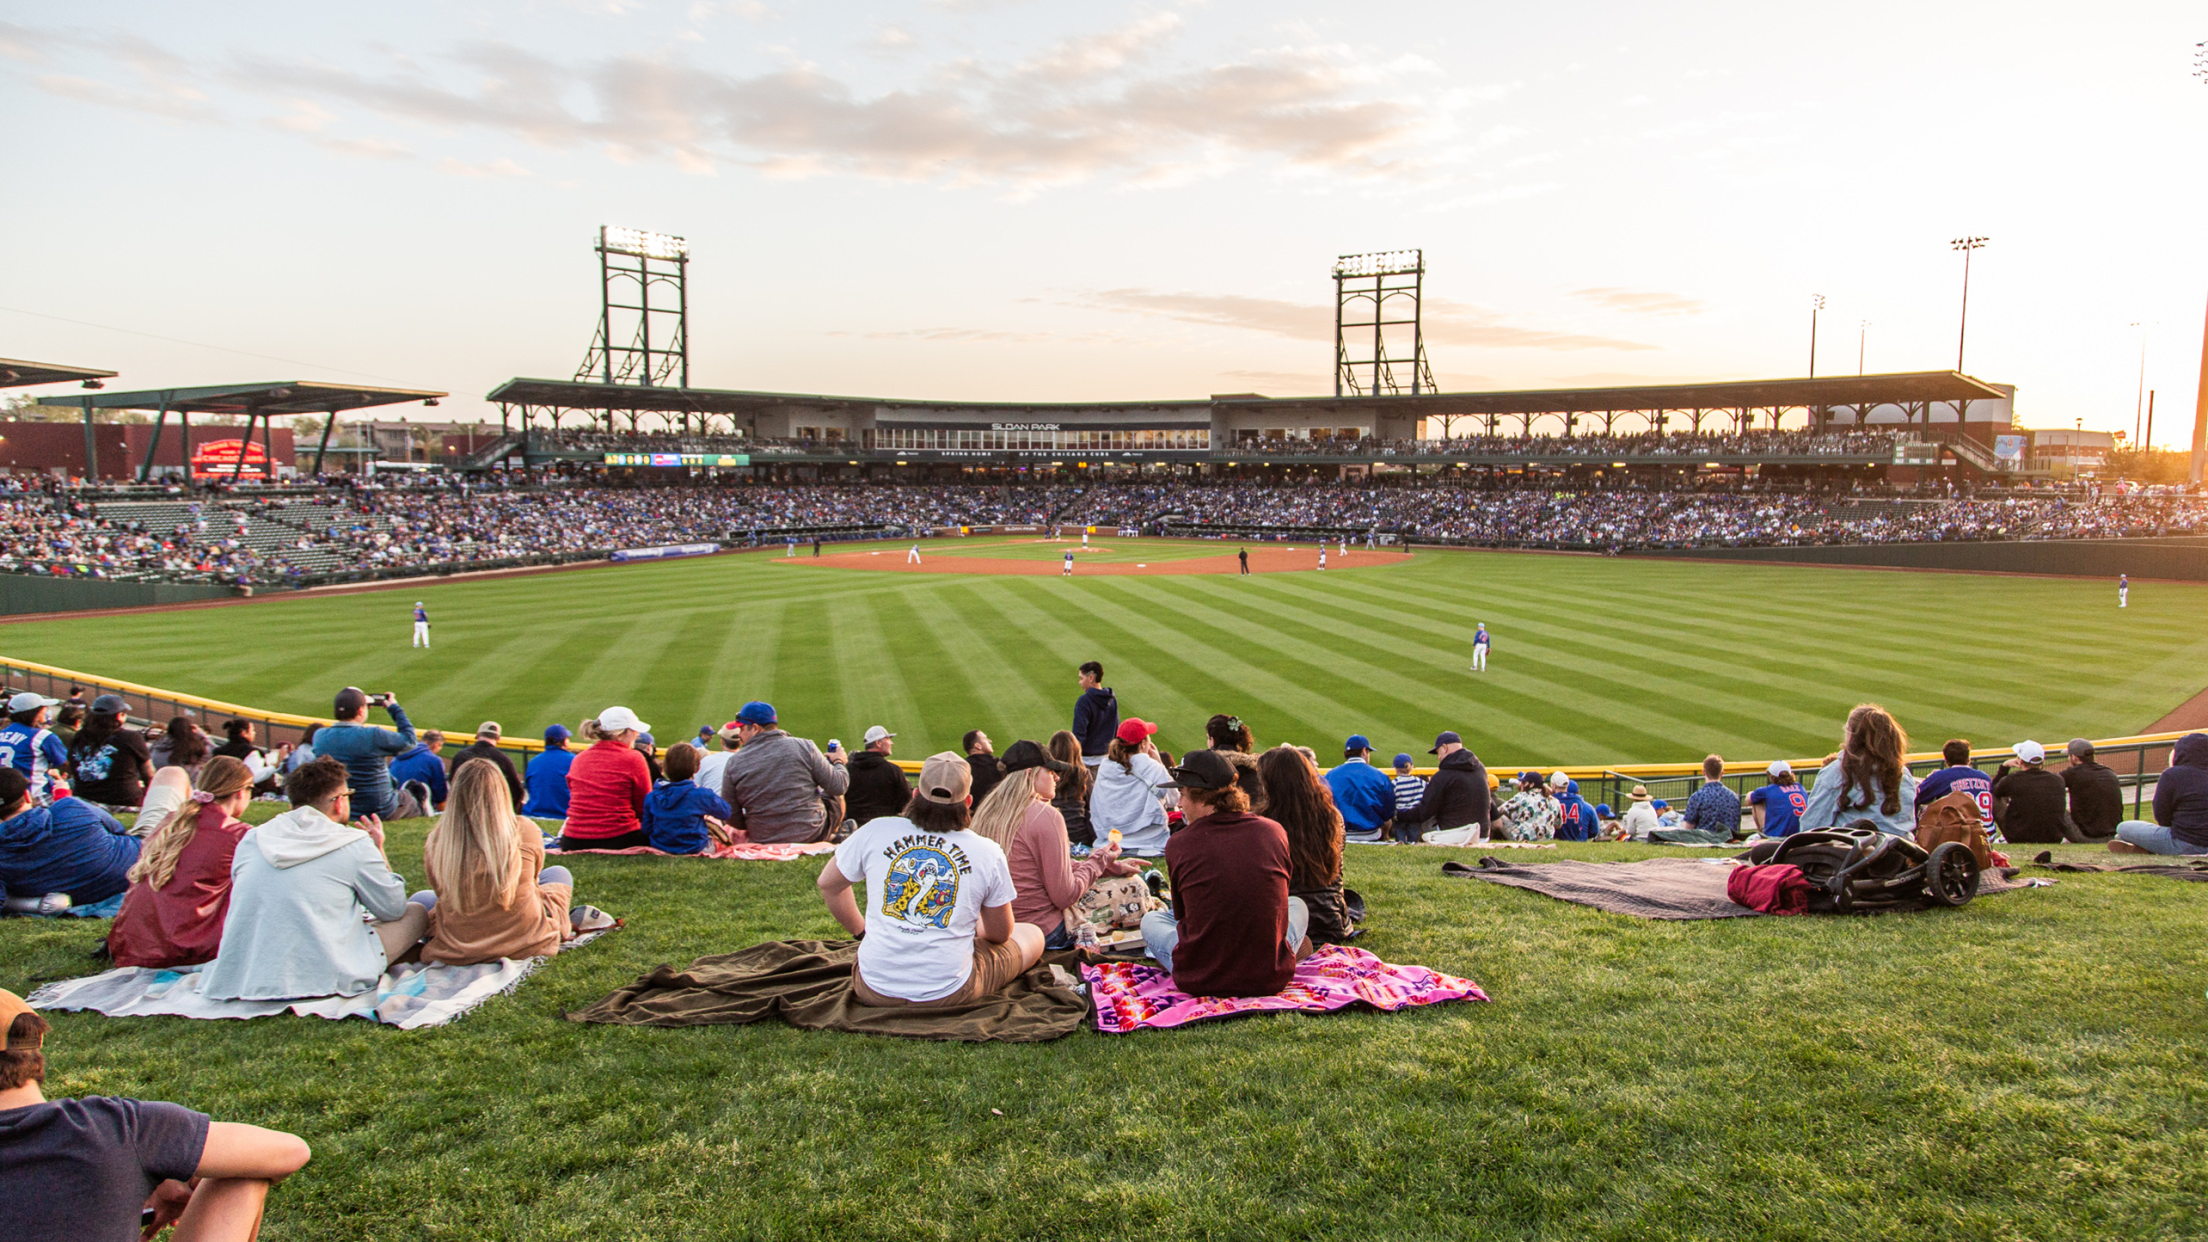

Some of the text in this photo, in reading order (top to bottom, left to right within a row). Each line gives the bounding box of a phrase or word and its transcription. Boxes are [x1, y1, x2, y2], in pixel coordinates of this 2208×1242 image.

[991, 423, 1060, 431] SLOAN PARK
[1789, 793, 1807, 817] 9
[883, 834, 972, 876] HAMMER TIME
